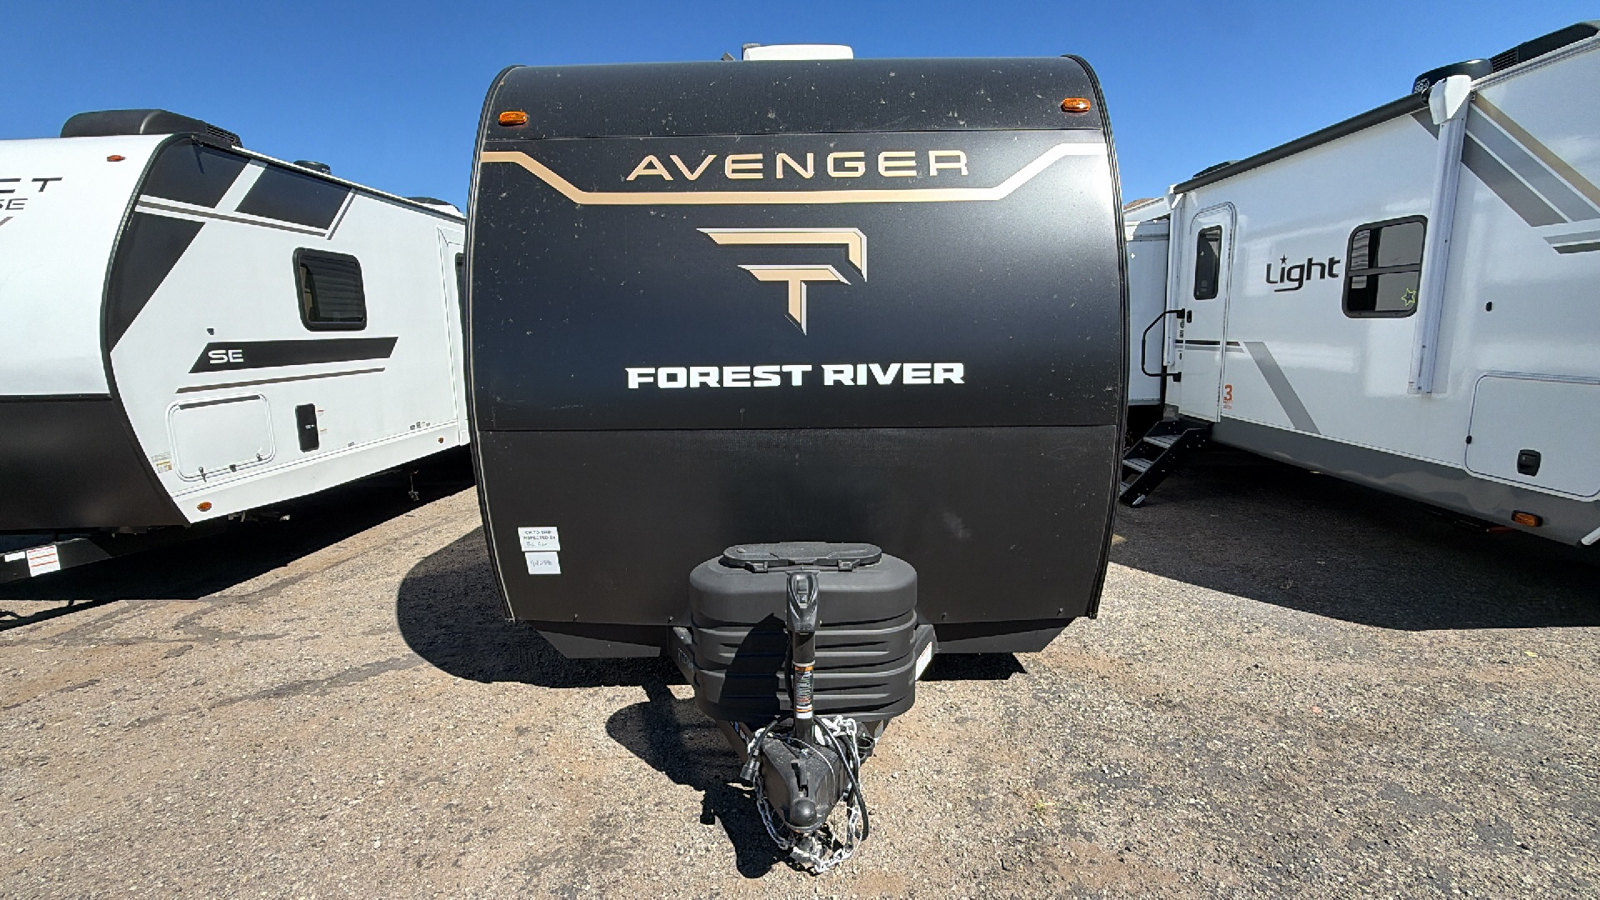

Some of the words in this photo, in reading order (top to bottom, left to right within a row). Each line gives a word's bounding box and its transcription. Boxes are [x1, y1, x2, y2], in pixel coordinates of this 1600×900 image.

[626, 150, 969, 181] AVENGER
[1265, 255, 1341, 292] Light
[208, 349, 244, 364] SE
[625, 365, 812, 389] FOREST
[821, 362, 965, 386] RIVER
[1223, 384, 1233, 400] 3
